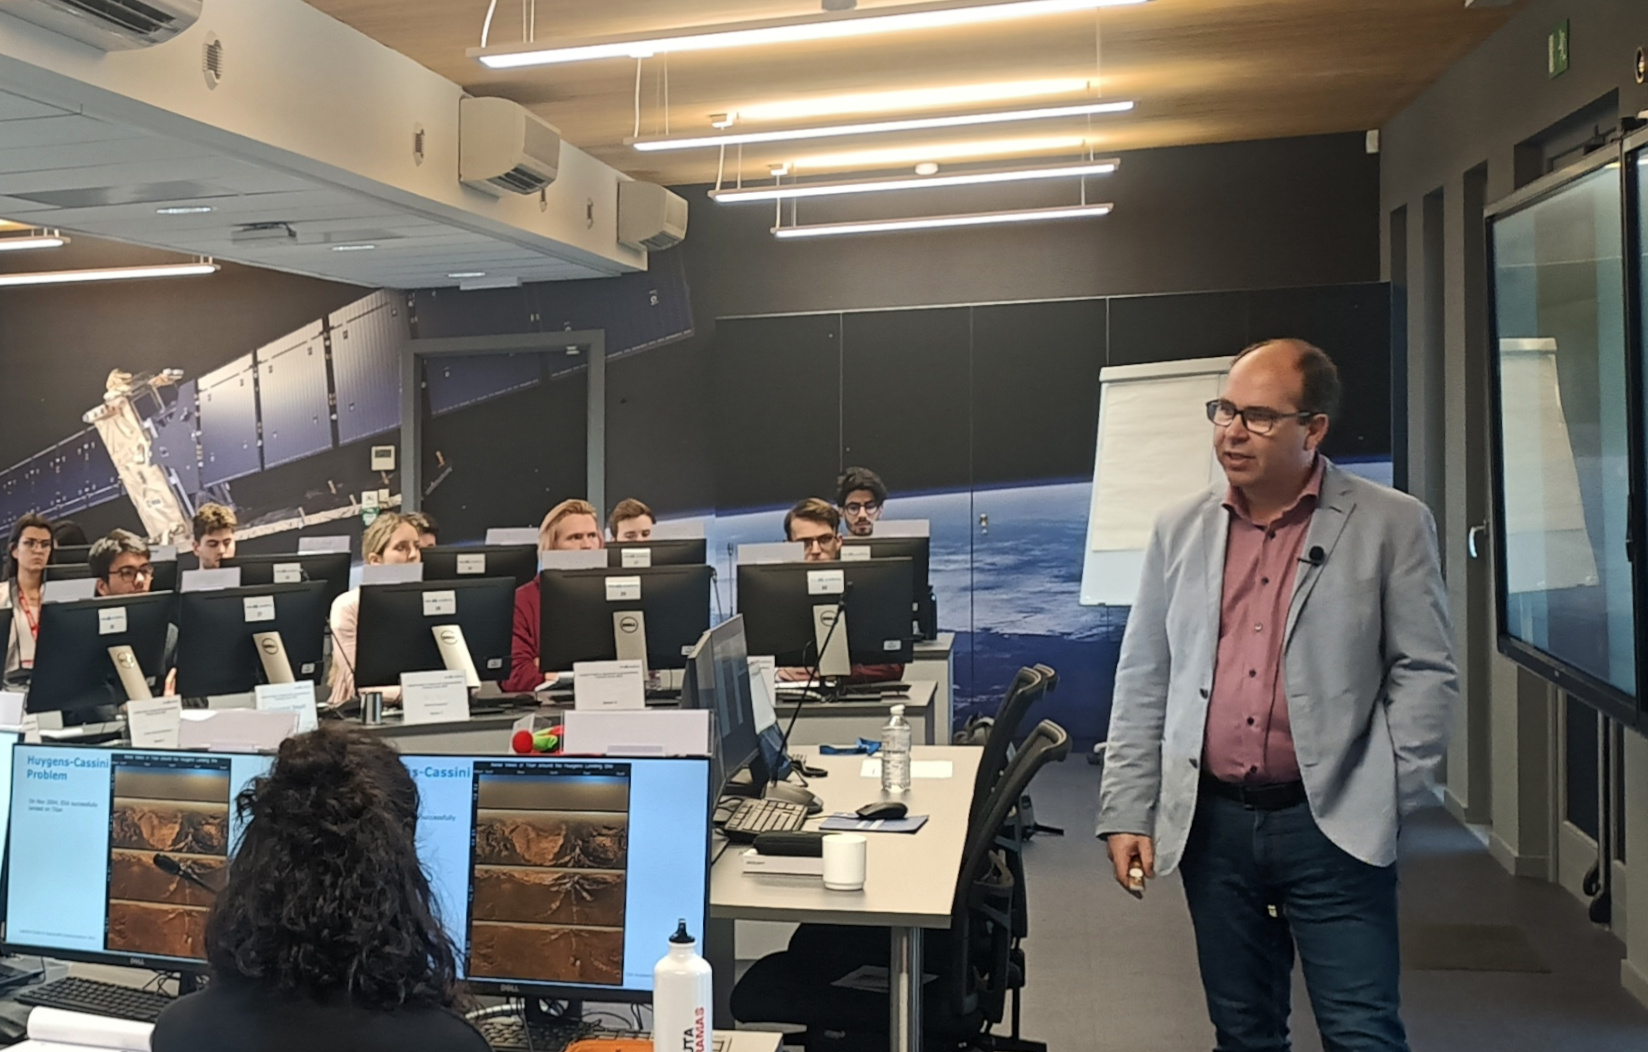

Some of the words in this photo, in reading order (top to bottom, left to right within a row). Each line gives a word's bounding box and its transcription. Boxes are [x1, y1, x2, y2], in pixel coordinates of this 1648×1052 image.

[26, 755, 109, 769] Huygens-Cassini
[26, 769, 68, 781] Problem
[410, 766, 471, 778] s-Cassini
